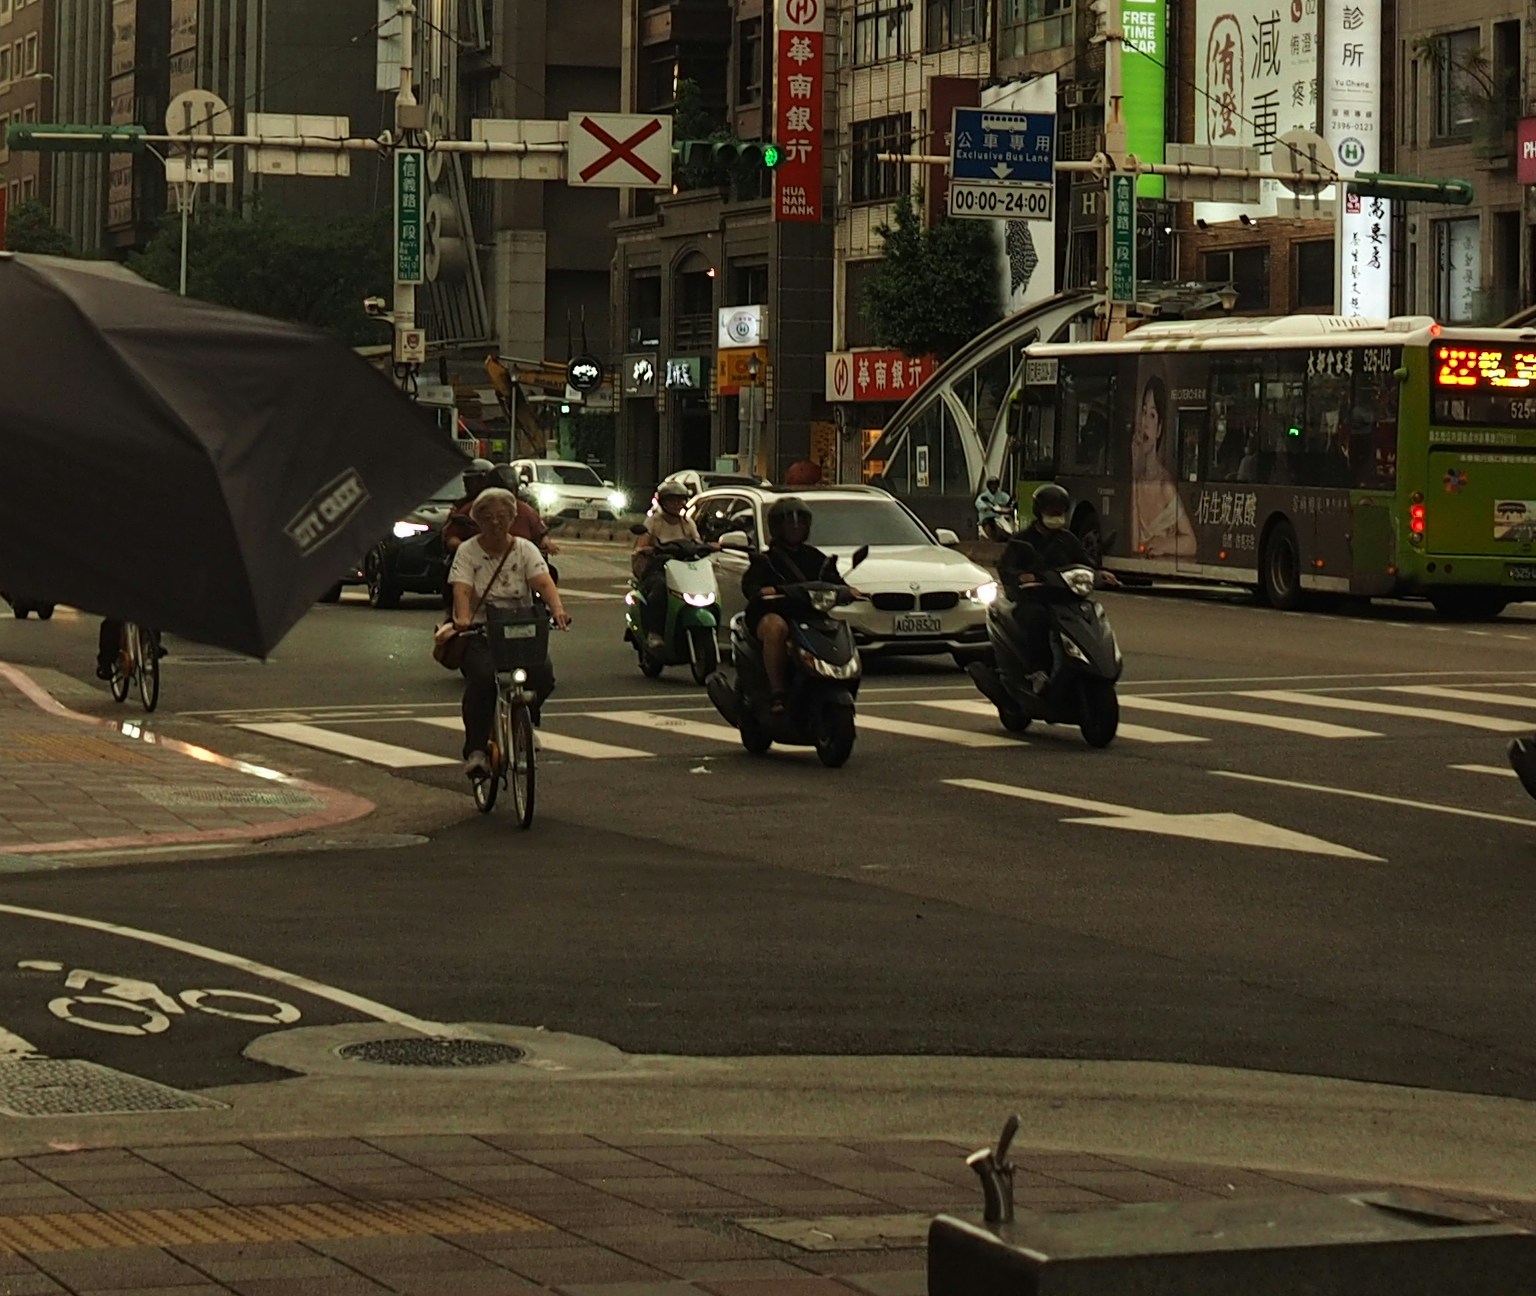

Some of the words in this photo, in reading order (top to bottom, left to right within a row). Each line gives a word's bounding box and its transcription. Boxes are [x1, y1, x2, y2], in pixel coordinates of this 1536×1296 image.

[1123, 11, 1156, 25] FREE
[1124, 25, 1156, 40] TIME
[1122, 40, 1157, 54] GEAR
[1251, 9, 1281, 155] 減重
[785, 36, 815, 165] 華南銀行
[957, 131, 1050, 152] 公車專用
[956, 149, 1004, 161] Exclusive
[1006, 152, 1024, 161] Bus
[1026, 154, 1049, 162] Lane
[402, 162, 417, 240] 信義路二段
[781, 196, 806, 206] NAN
[782, 186, 806, 197] HUA
[956, 190, 1047, 213] 00:00~24:00
[781, 205, 815, 216] BANK
[1117, 185, 1130, 261] 信義路二段
[1363, 347, 1391, 372] 525-U3
[857, 357, 922, 394] 華南銀行
[1194, 490, 1257, 528] 仿生玻尿酸
